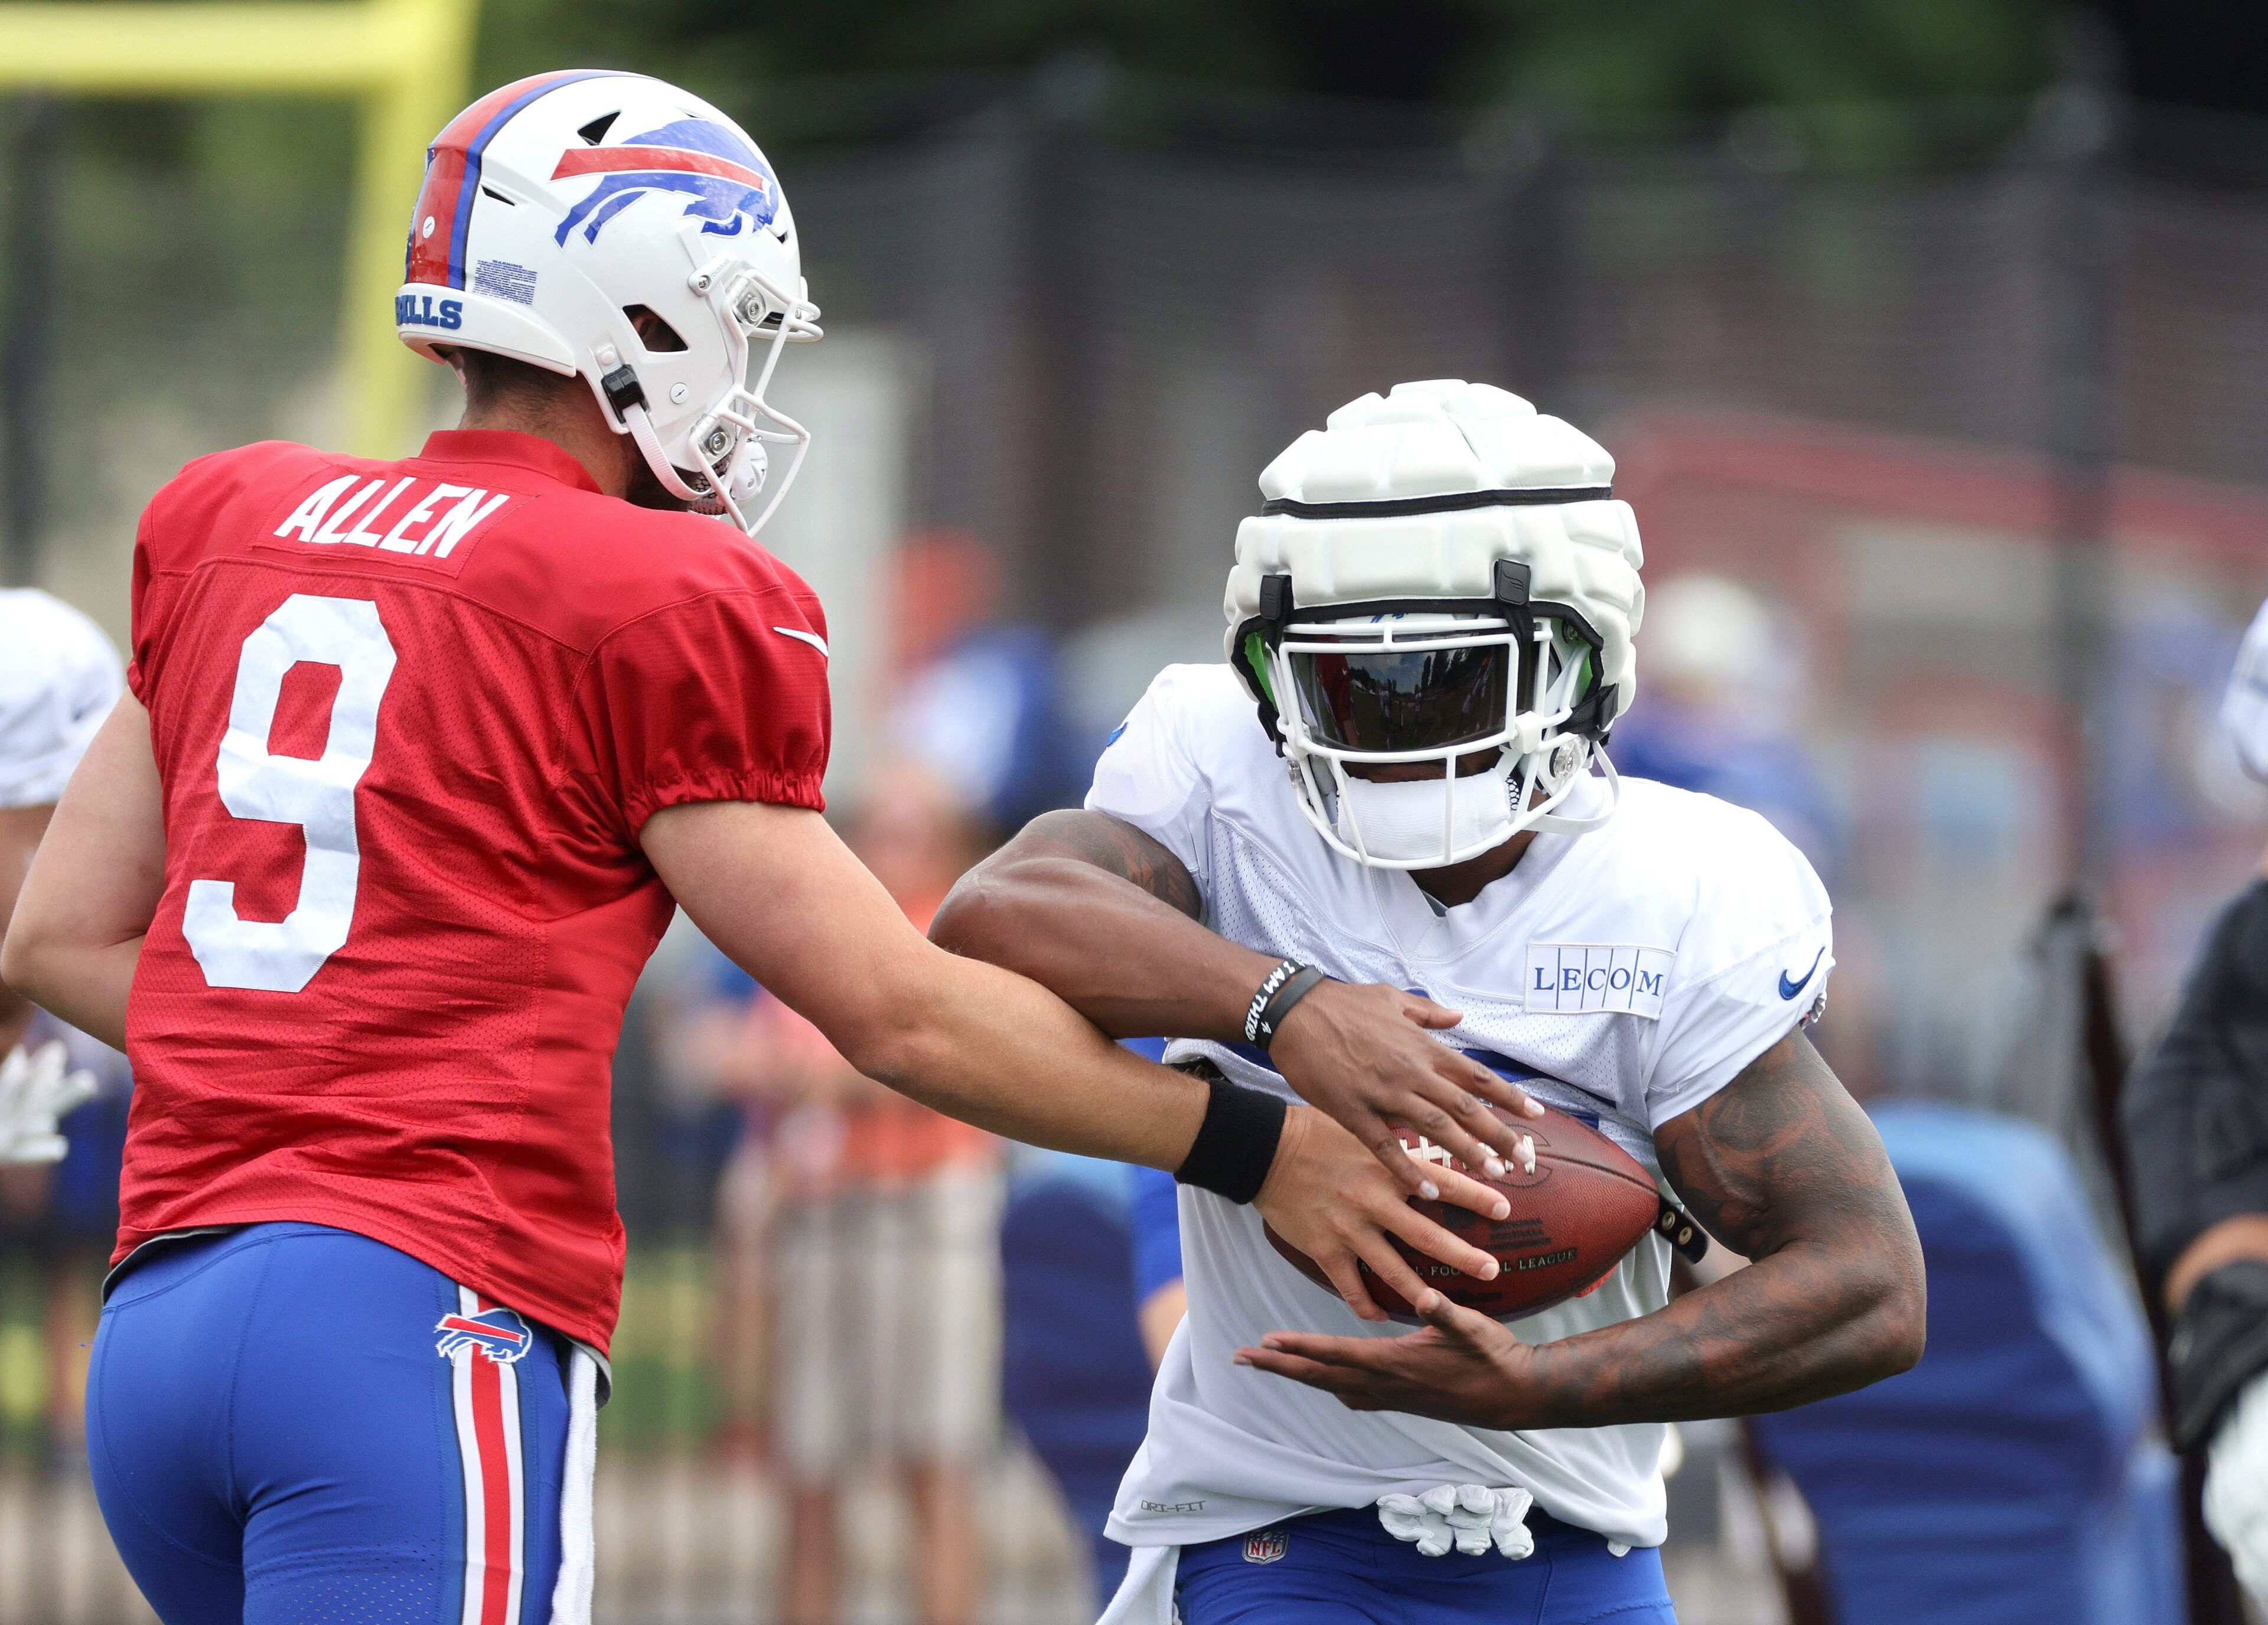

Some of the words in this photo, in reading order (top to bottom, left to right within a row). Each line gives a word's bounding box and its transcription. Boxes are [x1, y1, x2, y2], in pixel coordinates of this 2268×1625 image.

[492, 259, 523, 269] WARNING
[273, 474, 510, 559] ALLEN
[182, 593, 397, 993] 9
[1282, 960, 1296, 974] I
[1263, 967, 1285, 994] AM
[1534, 967, 1664, 996] LECOM
[1244, 994, 1268, 1042] THIRD
[1518, 1248, 1576, 1271] LEAGUE
[1140, 1500, 1205, 1512] DRI-FIT
[1250, 1541, 1280, 1558] NFL
